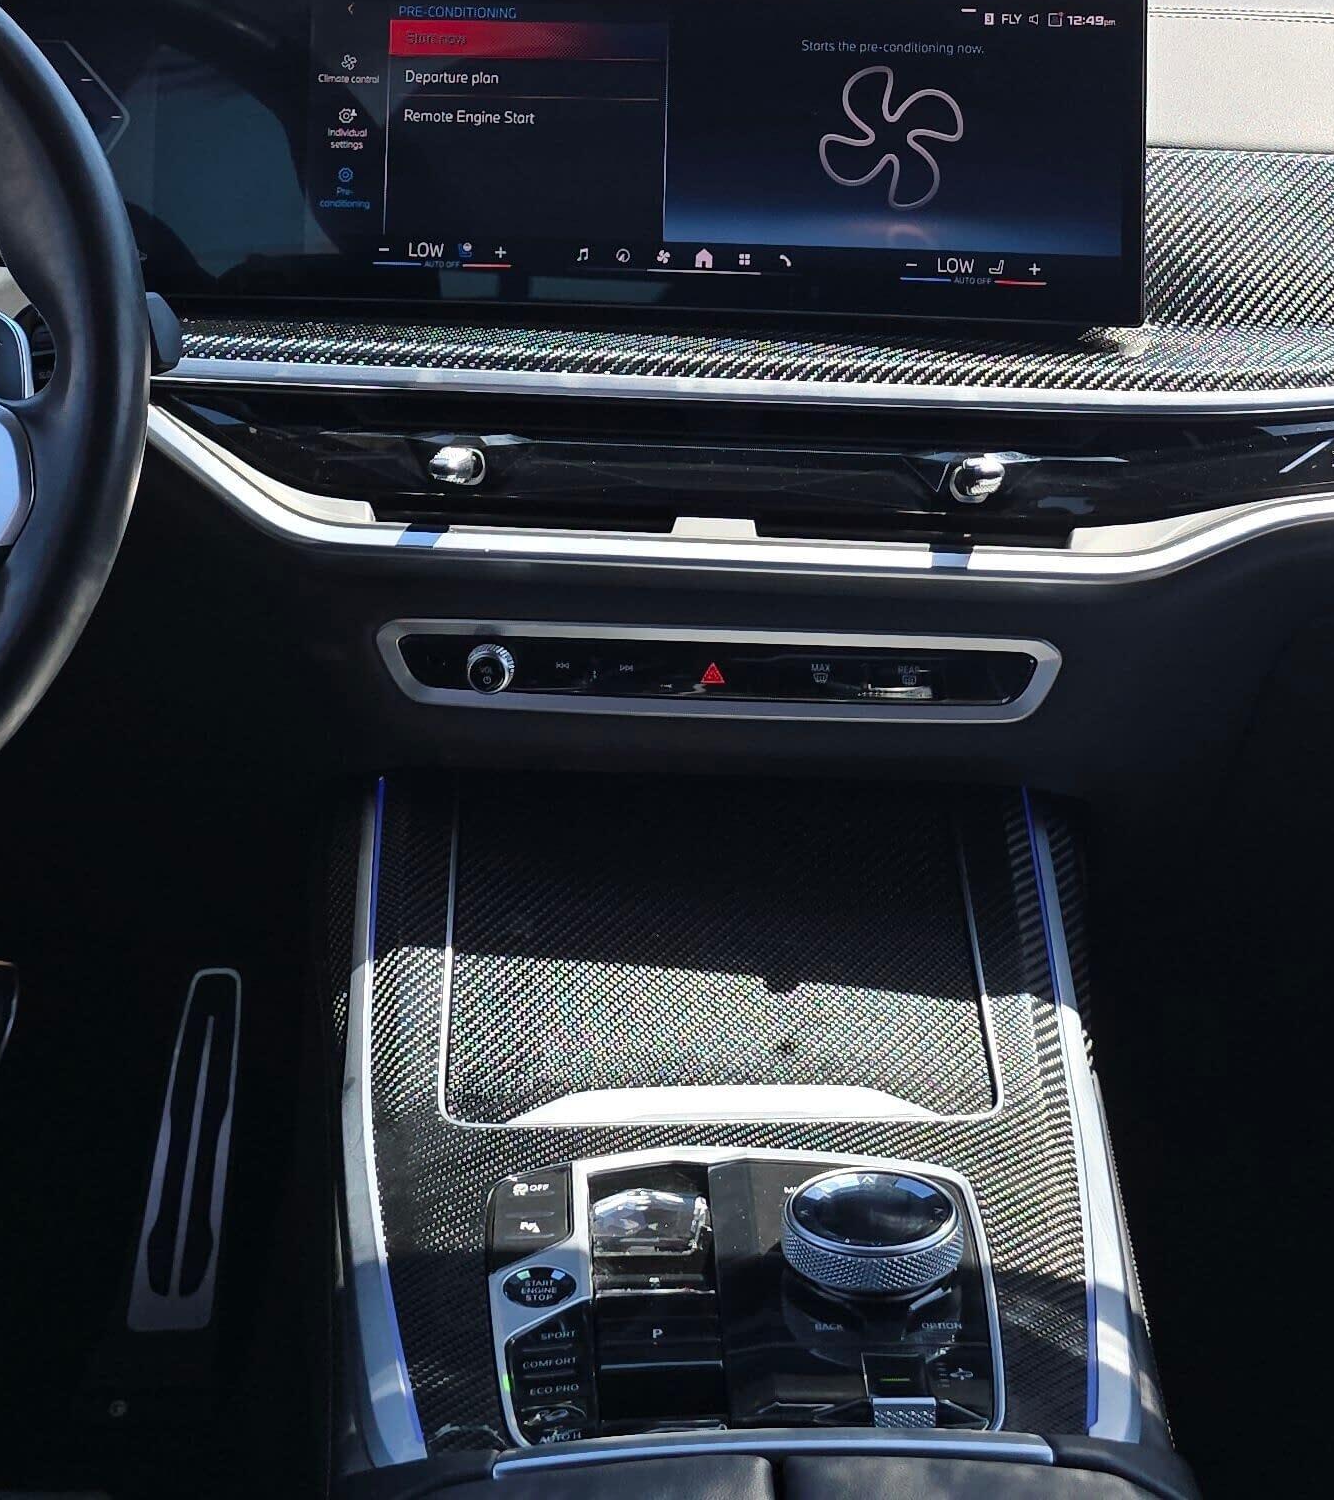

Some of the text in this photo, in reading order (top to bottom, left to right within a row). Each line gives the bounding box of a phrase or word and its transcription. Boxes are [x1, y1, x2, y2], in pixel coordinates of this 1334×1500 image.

[398, 5, 517, 19] PRE-CONDITIONING
[1001, 13, 1022, 25] FLY
[801, 40, 985, 56] Starts the pre-conditioning now.
[317, 73, 380, 84] Climate control
[405, 69, 499, 86] Departure plan
[404, 108, 536, 126] Remote Engine Start
[328, 127, 368, 138] Individual
[330, 139, 364, 151] settings
[336, 186, 354, 196] Pre-
[319, 199, 370, 211] conditioning
[408, 242, 444, 258] LOW
[423, 260, 460, 269] AUTO OFF
[937, 257, 975, 274] LOW
[953, 276, 992, 285] AUTO OFF
[810, 663, 830, 672] MAX
[529, 1183, 550, 1192] OFF
[525, 1279, 555, 1287] START
[521, 1286, 557, 1295] ENGINE
[525, 1294, 553, 1302] STOP
[540, 1330, 576, 1341] SPORT
[652, 1328, 663, 1339] P
[522, 1356, 577, 1370] COMFORT
[529, 1383, 580, 1396] ECO PRO
